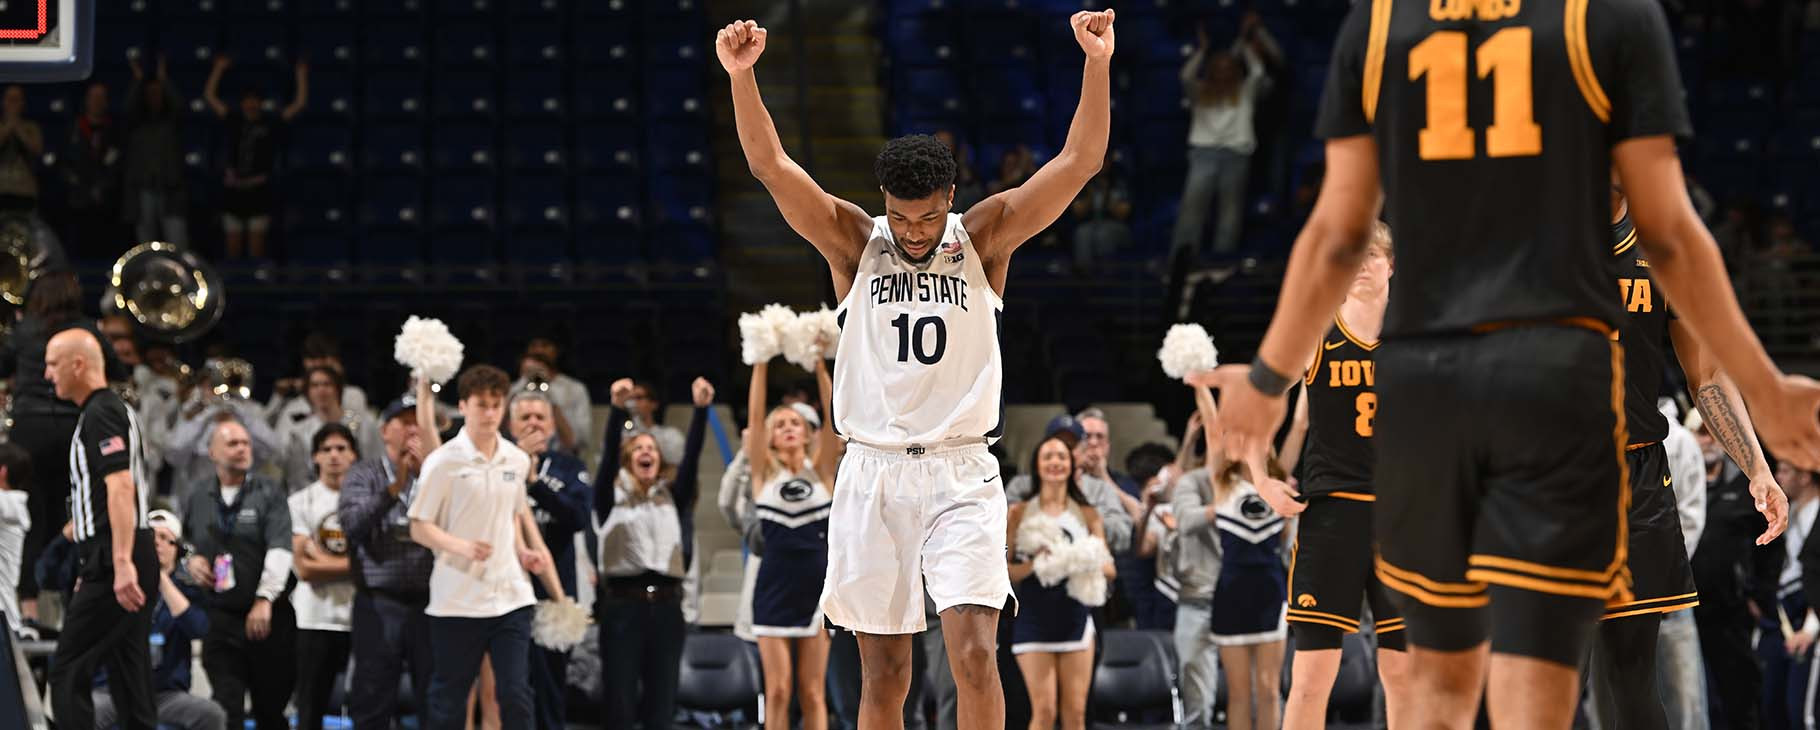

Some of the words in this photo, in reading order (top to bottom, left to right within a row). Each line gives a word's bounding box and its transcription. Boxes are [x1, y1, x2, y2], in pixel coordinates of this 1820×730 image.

[1408, 26, 1543, 161] 11
[870, 272, 913, 309] PENN
[917, 272, 968, 312] STATE
[891, 313, 947, 365] 10
[1355, 391, 1377, 437] 8
[906, 447, 926, 455] PSU
